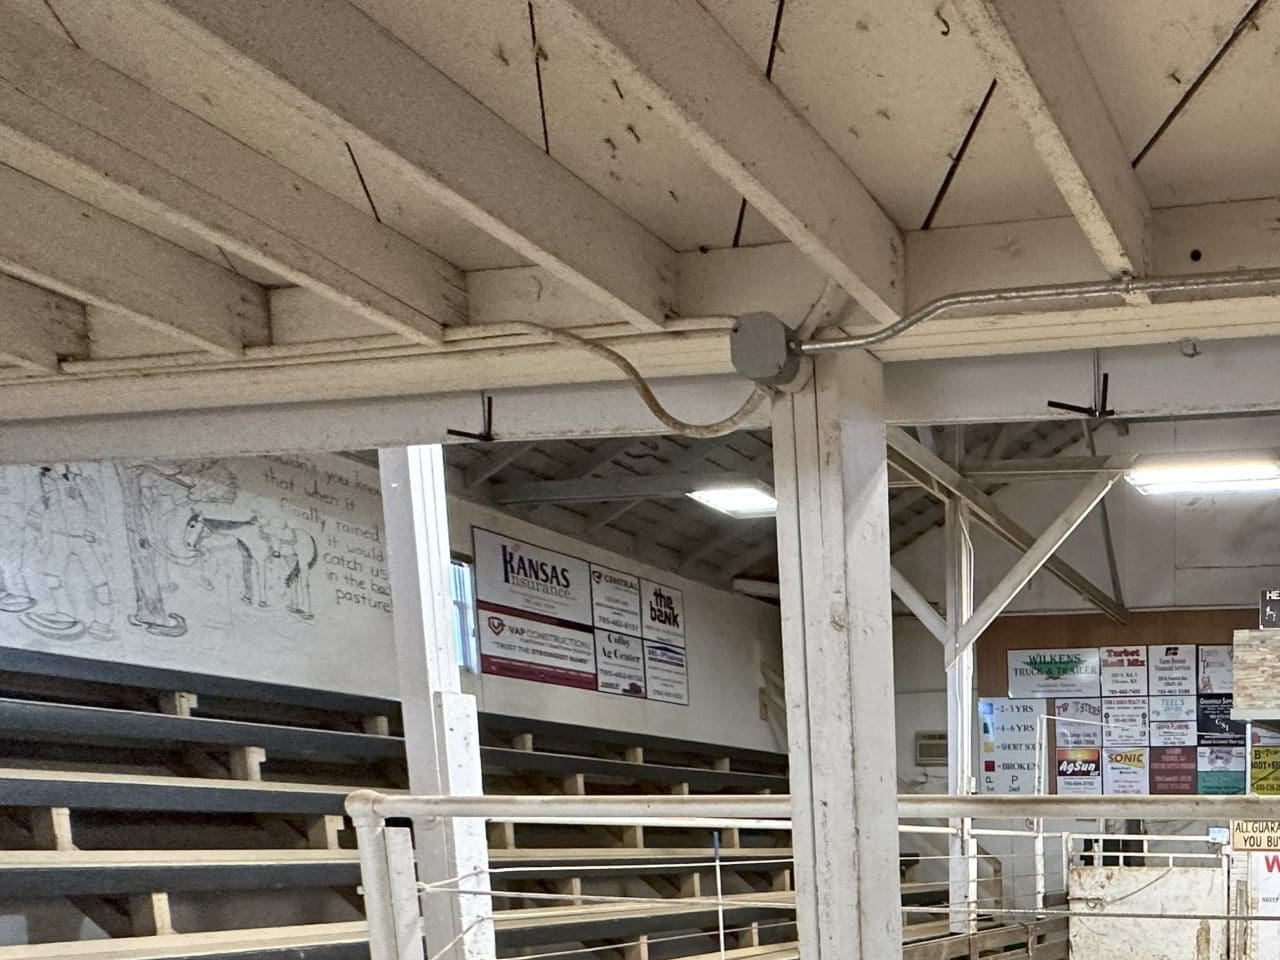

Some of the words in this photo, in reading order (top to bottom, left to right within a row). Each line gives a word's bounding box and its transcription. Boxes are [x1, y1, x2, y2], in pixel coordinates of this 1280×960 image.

[264, 467, 296, 492] that
[304, 480, 338, 505] when
[345, 501, 356, 511] it
[336, 522, 380, 543] rained
[328, 537, 338, 548] it
[347, 546, 384, 562] would
[323, 552, 362, 572] catch
[371, 567, 390, 581] us
[501, 544, 570, 589] KANSAS
[344, 574, 366, 590] the
[653, 588, 674, 612] the
[649, 600, 680, 629] bank
[1029, 653, 1082, 665] WILKENS
[1013, 667, 1042, 677] TRUCK
[1057, 666, 1097, 676] TRAILER
[1059, 760, 1096, 774] AgSun
[1107, 753, 1144, 763] SONIC
[1235, 821, 1249, 834] ALL
[1243, 835, 1262, 848] YOU
